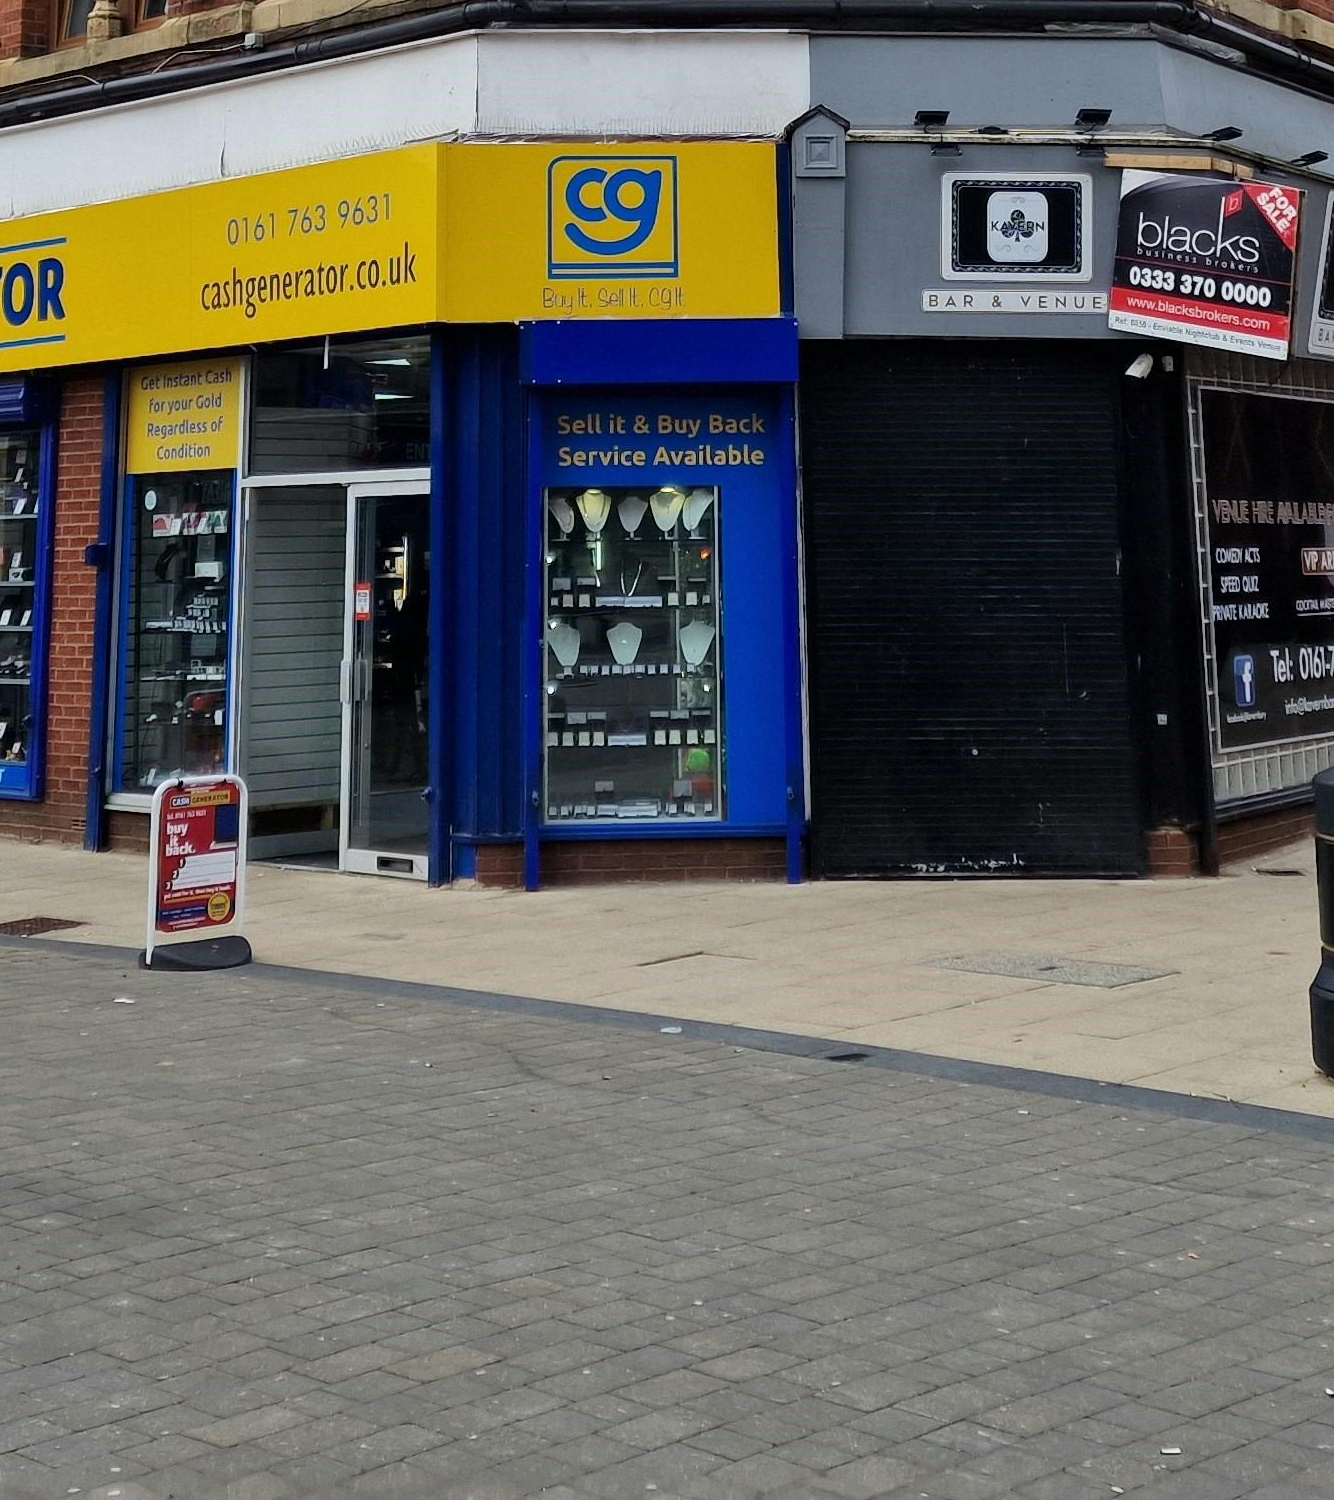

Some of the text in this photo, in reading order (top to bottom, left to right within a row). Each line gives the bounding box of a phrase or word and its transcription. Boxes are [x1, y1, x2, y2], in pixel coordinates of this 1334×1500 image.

[565, 167, 662, 256] cg
[1256, 192, 1291, 233] SALE
[1268, 187, 1298, 219] FOR
[227, 193, 391, 246] 0161 763 9631
[990, 220, 1045, 232] KAVERN
[1137, 196, 1260, 262] blacks
[1136, 247, 1259, 274] business brokers
[201, 241, 416, 318] cashgenerator.co.uk
[1129, 266, 1272, 308] 0333 370 0000
[542, 287, 573, 314] Buy
[597, 287, 625, 308] Sell
[928, 295, 1103, 309] BAR & VENUE
[1126, 296, 1271, 331] www.blacksbrokers.com
[141, 375, 160, 391] Get
[205, 368, 232, 384] Cash
[167, 393, 222, 416] your Gold
[146, 416, 224, 440] Regardless of
[557, 413, 765, 438] Sell it & Buy Back
[156, 443, 211, 460] Condition
[558, 444, 765, 467] Service Available
[1212, 499, 1250, 525] VENUE
[1251, 500, 1276, 525] HIRE
[1215, 547, 1261, 563] COMEDY ACTS
[1303, 551, 1319, 571] VIP
[1220, 575, 1259, 593] SPEED QUIZ
[1238, 602, 1270, 620] KARAOKE
[1270, 648, 1294, 683] Tel:
[172, 797, 190, 806] CASH
[167, 822, 188, 837] buy
[165, 841, 196, 857] back.
